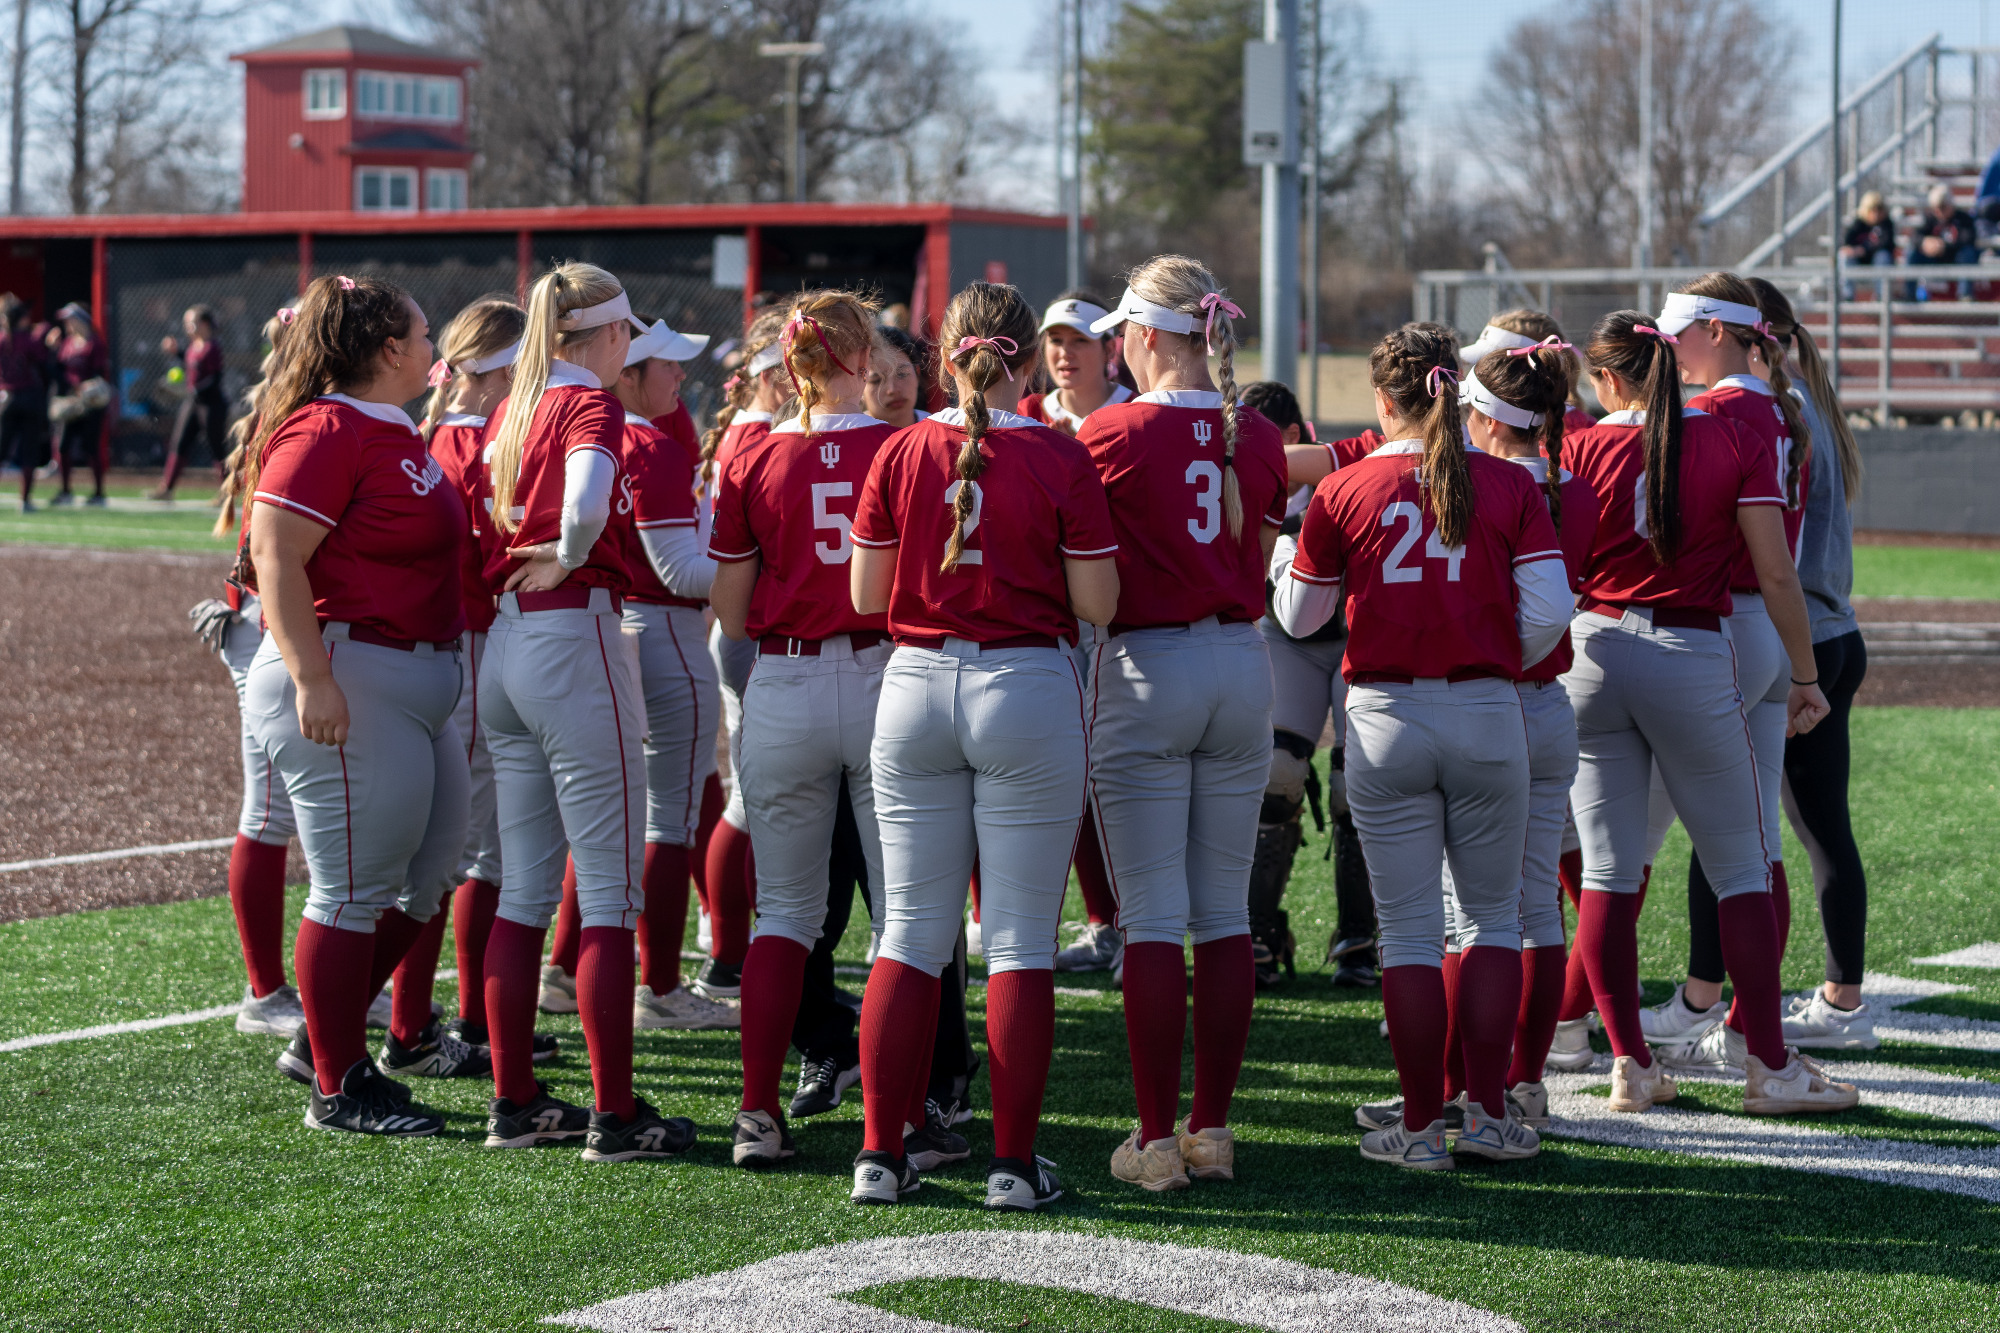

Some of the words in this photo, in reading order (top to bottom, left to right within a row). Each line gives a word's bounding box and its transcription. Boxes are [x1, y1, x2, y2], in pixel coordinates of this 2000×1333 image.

[812, 481, 853, 565] 5
[944, 480, 984, 566] 2
[1185, 460, 1222, 544] 3
[1381, 501, 1466, 584] 24
